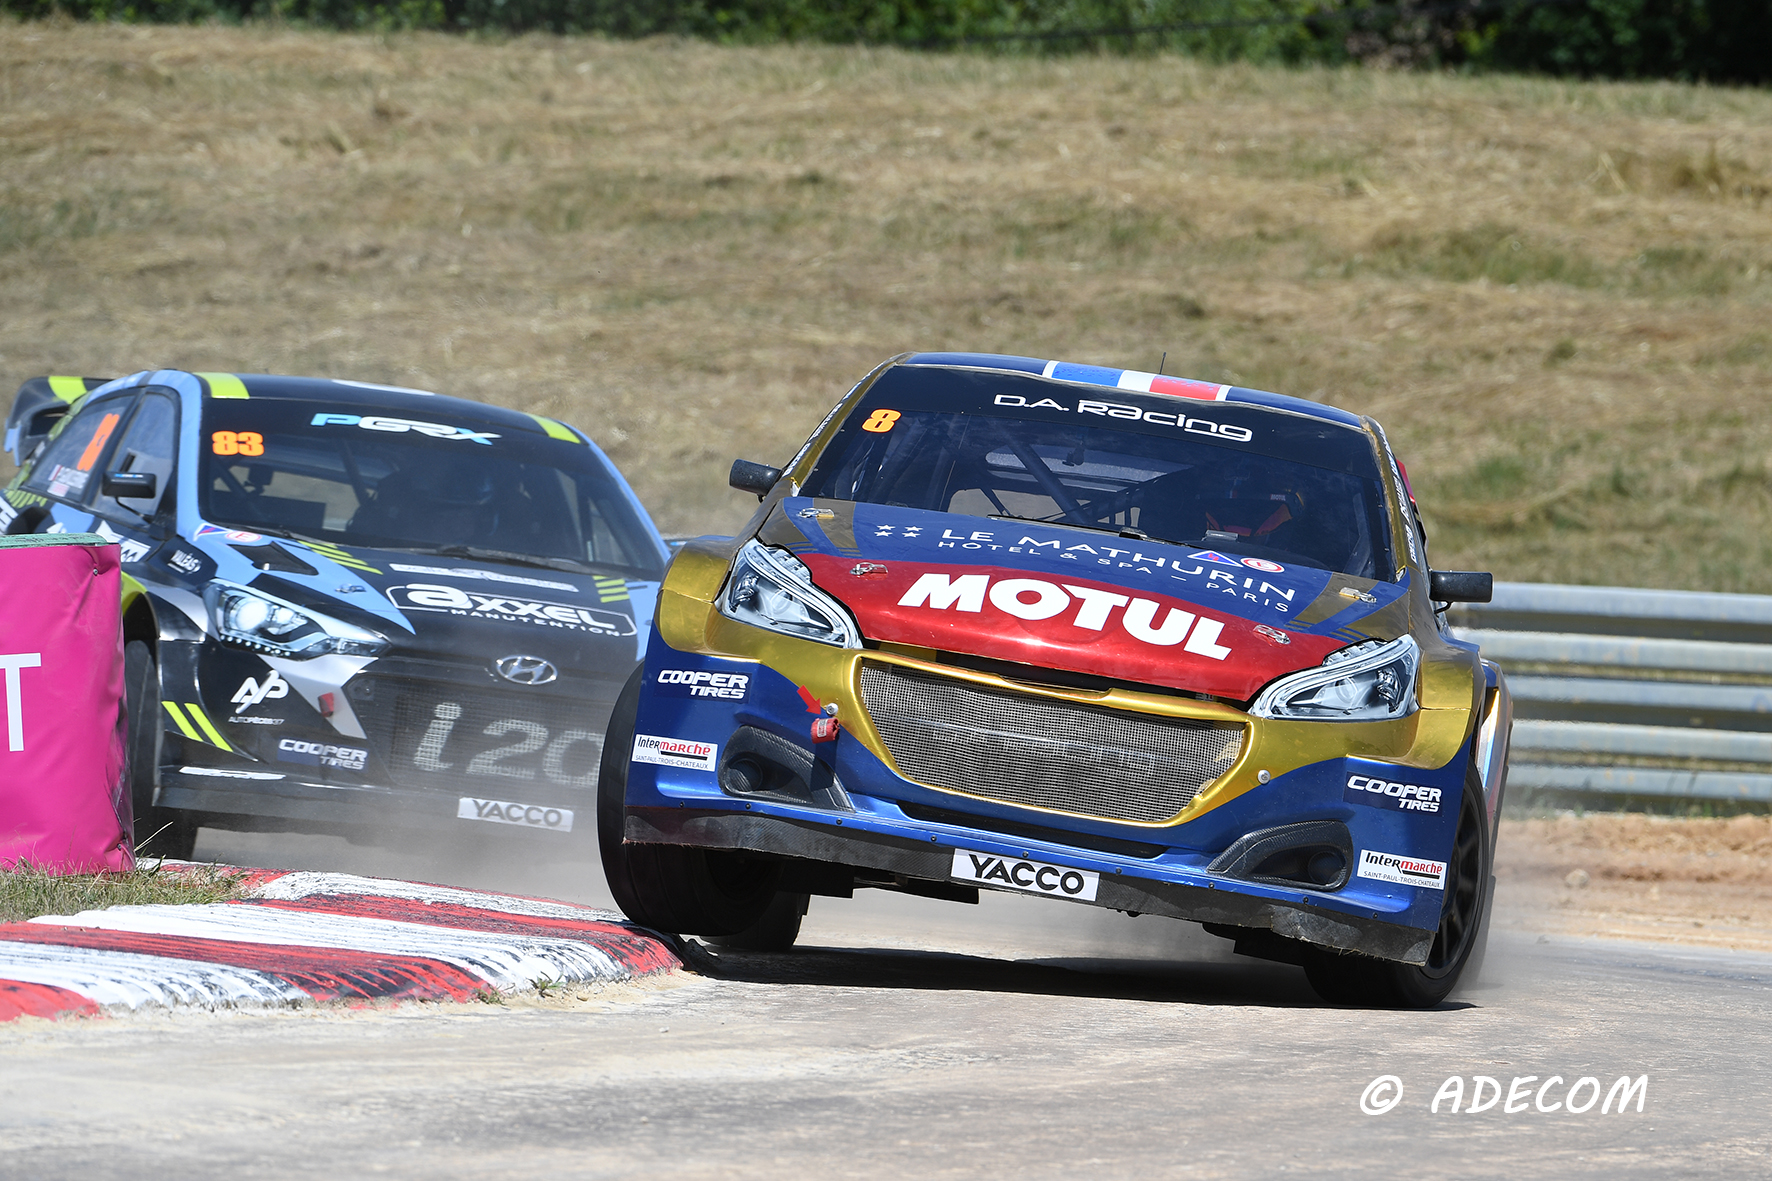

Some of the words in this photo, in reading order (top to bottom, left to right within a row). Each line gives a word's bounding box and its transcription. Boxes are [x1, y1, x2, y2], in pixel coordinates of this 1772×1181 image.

[861, 407, 902, 433] 8
[993, 394, 1070, 413] D.A.
[1076, 399, 1253, 443] Racing
[212, 430, 264, 456] 83
[942, 529, 995, 543] LE
[1017, 536, 1296, 602] MATHURIN
[1060, 552, 1078, 561] &
[1097, 558, 1153, 575] SPA
[1206, 582, 1289, 613] PARIS
[450, 608, 621, 637] MANUTENTION
[896, 572, 1233, 661] MOTUL
[657, 669, 749, 689] COOPER
[689, 684, 746, 700] TIRES
[278, 738, 369, 762] COOPER
[320, 755, 365, 771] TIRES
[1347, 775, 1443, 803] COOPER
[472, 799, 563, 827] YACCO
[1398, 798, 1440, 813] TIRES
[968, 853, 1085, 895] YACCO
